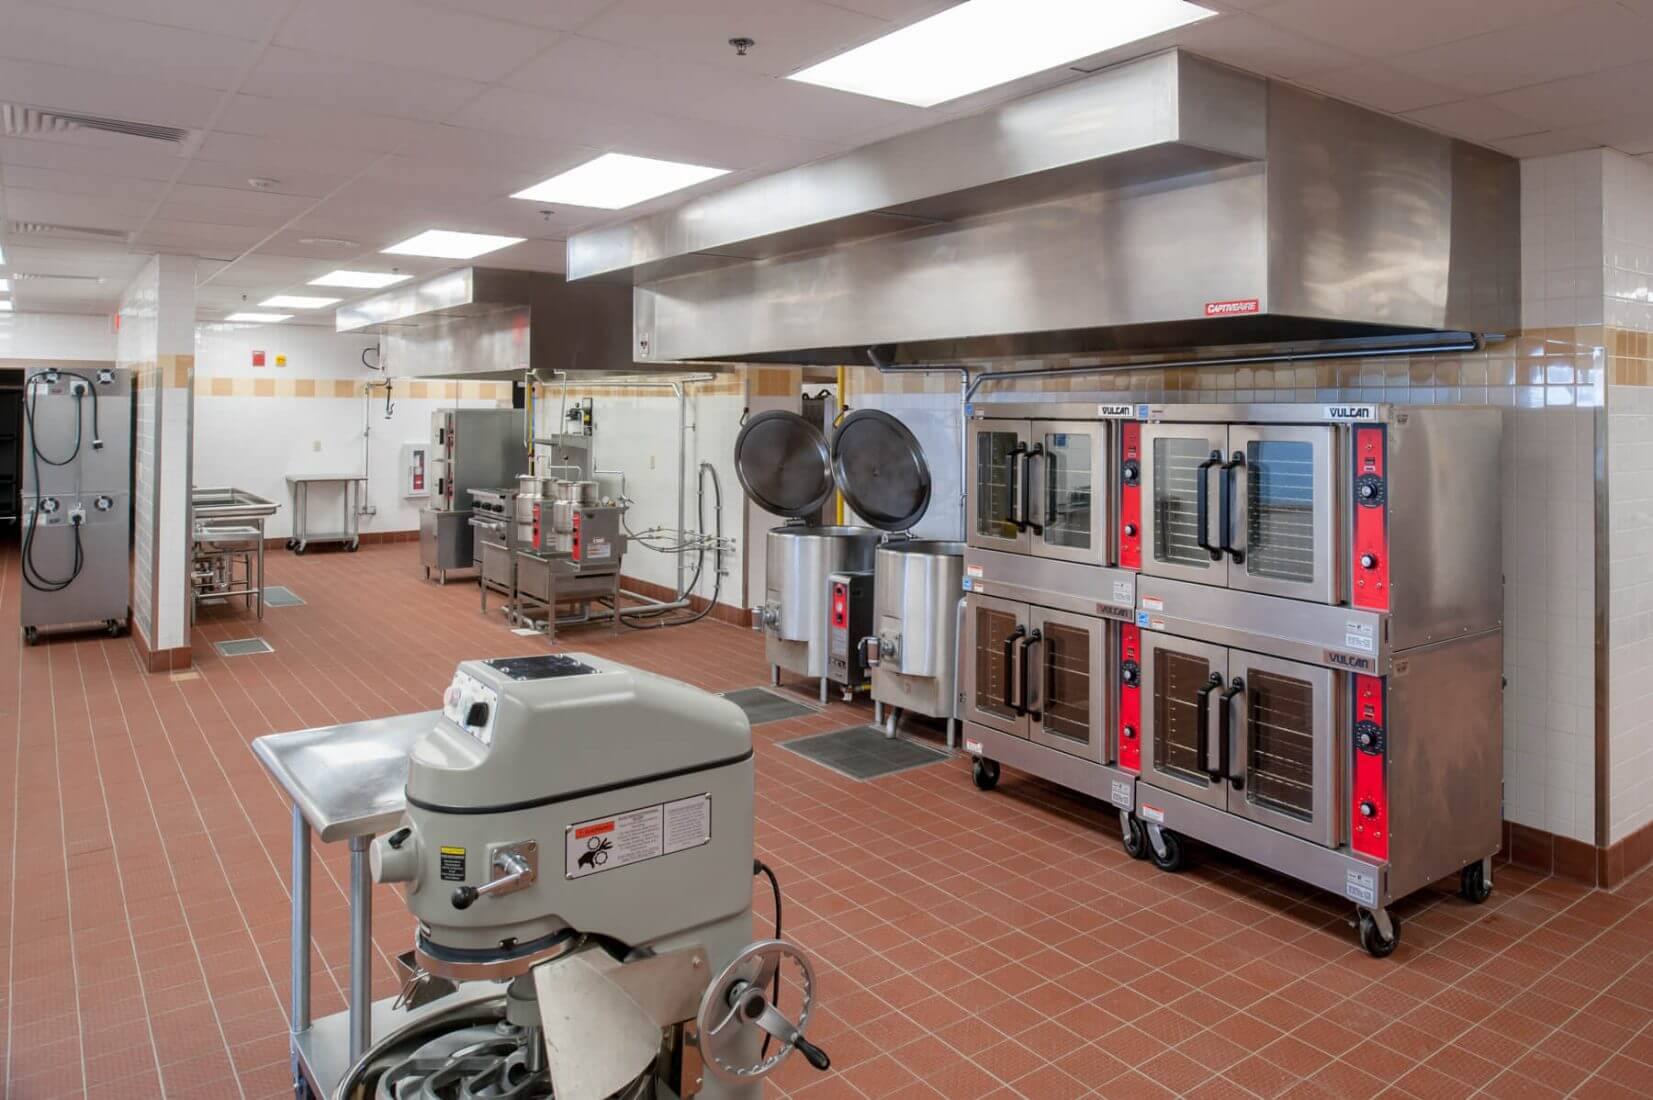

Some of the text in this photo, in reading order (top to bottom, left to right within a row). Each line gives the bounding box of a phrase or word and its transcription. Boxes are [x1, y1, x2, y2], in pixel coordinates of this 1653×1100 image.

[1101, 406, 1130, 415] VULCAN
[1329, 407, 1370, 418] VULCAN
[1328, 652, 1369, 669] VULCAN
